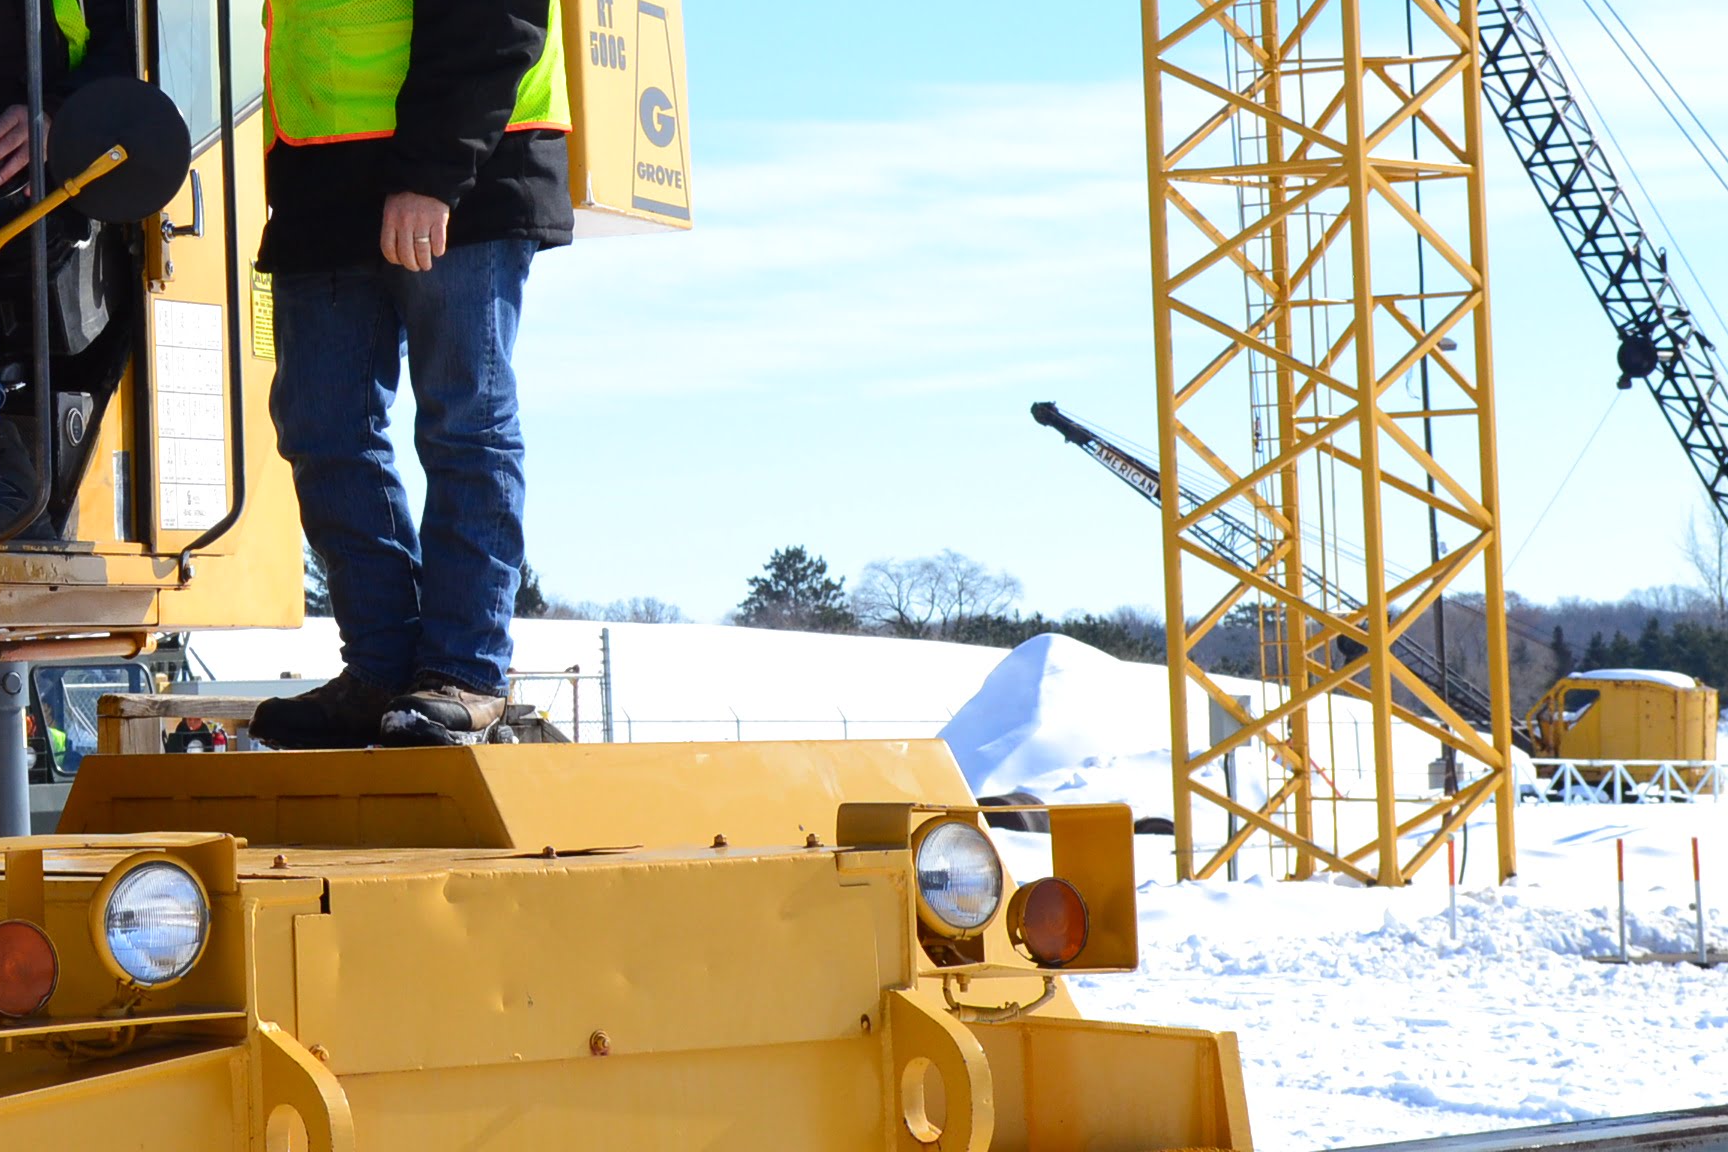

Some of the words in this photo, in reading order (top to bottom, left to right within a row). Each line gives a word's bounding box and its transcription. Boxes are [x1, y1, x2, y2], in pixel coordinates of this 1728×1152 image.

[639, 86, 675, 148] G
[636, 161, 682, 189] GROVE
[1095, 447, 1156, 494] AMERICAN
